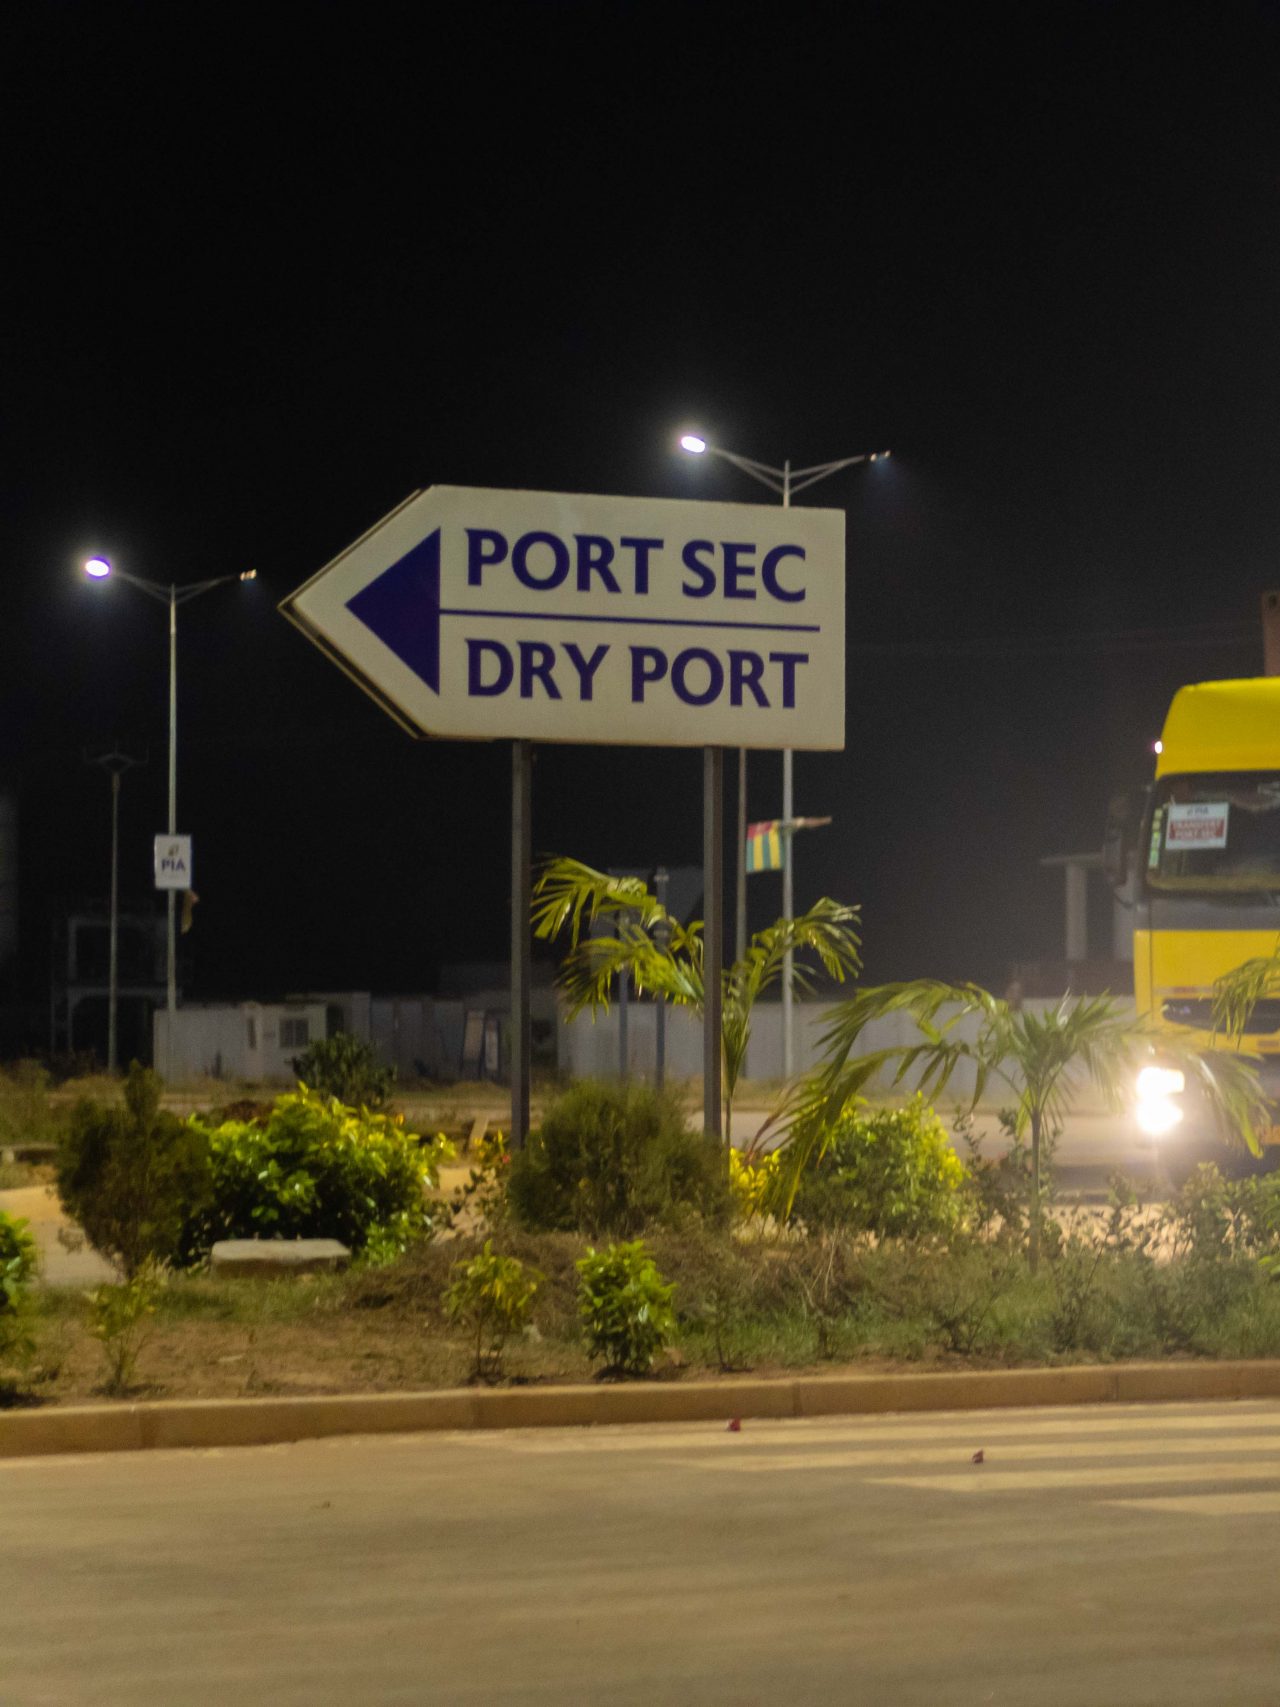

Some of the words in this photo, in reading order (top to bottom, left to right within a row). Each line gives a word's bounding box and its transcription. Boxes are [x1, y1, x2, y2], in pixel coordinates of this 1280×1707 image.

[463, 528, 664, 595] PORT
[680, 540, 807, 603] SEC
[463, 638, 611, 702] DRY
[628, 645, 809, 709] PORT
[161, 858, 186, 872] PIA
